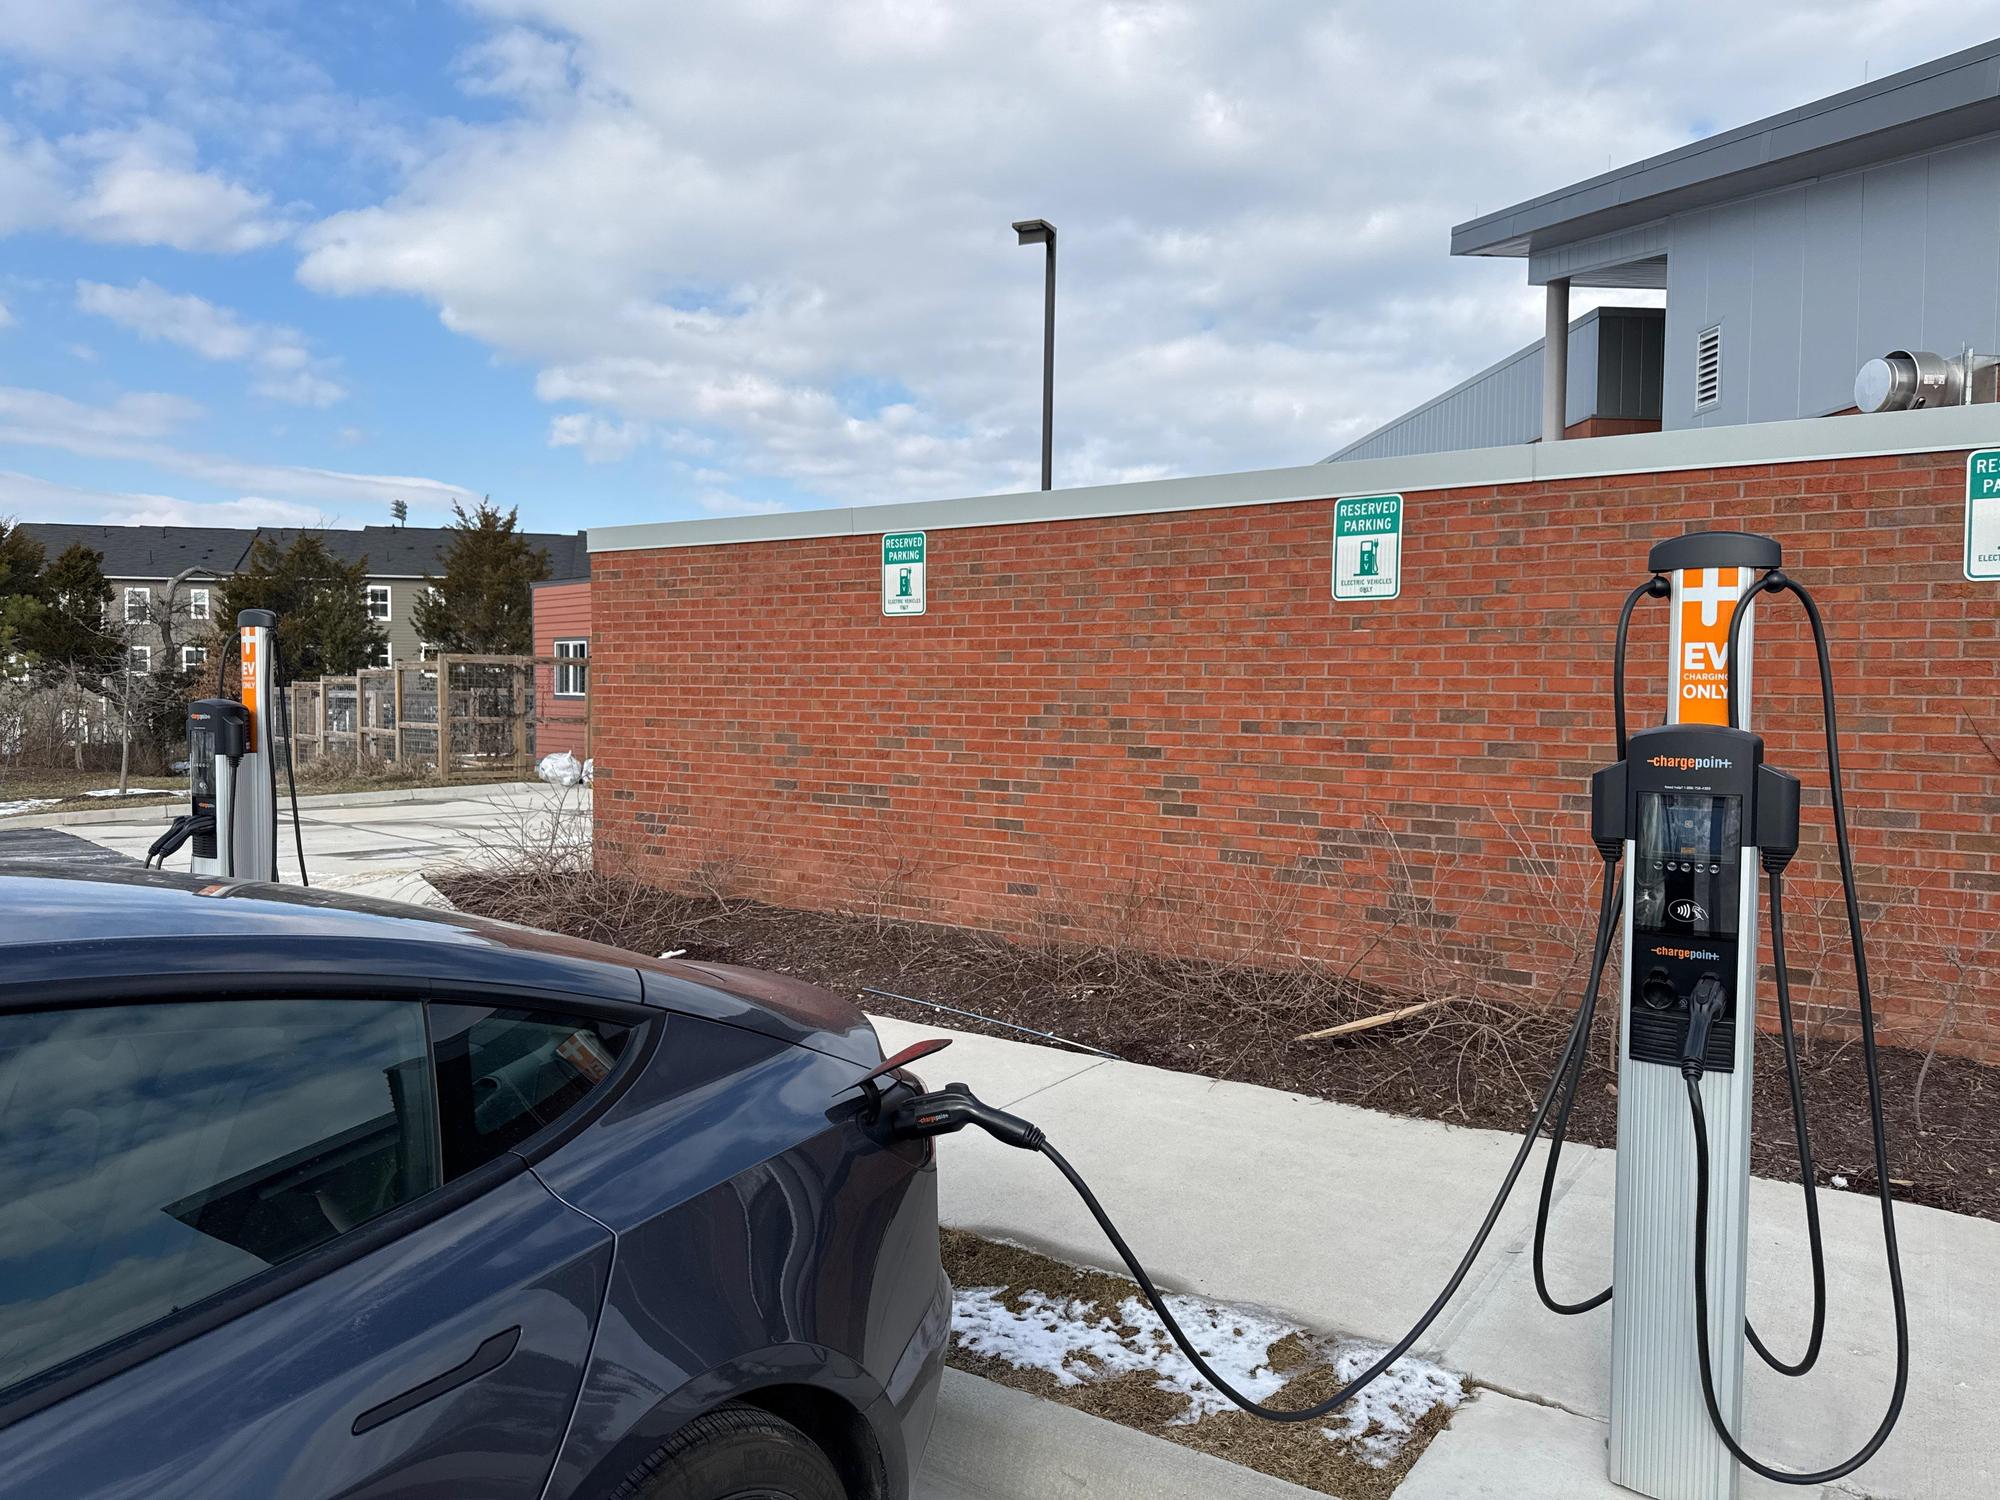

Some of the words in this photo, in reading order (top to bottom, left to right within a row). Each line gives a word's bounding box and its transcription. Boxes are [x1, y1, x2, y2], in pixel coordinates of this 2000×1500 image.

[1977, 458, 2000, 473] RE
[1340, 501, 1397, 517] RESERVED
[1344, 518, 1392, 532] PARKING
[886, 537, 922, 548] RESERVED
[889, 550, 919, 561] PARKING
[1684, 642, 1728, 670] EV
[242, 661, 255, 675] EV
[1683, 684, 1728, 699] ONLY
[1647, 754, 1732, 770] chargepoint
[1651, 945, 1720, 961] chargepoint
